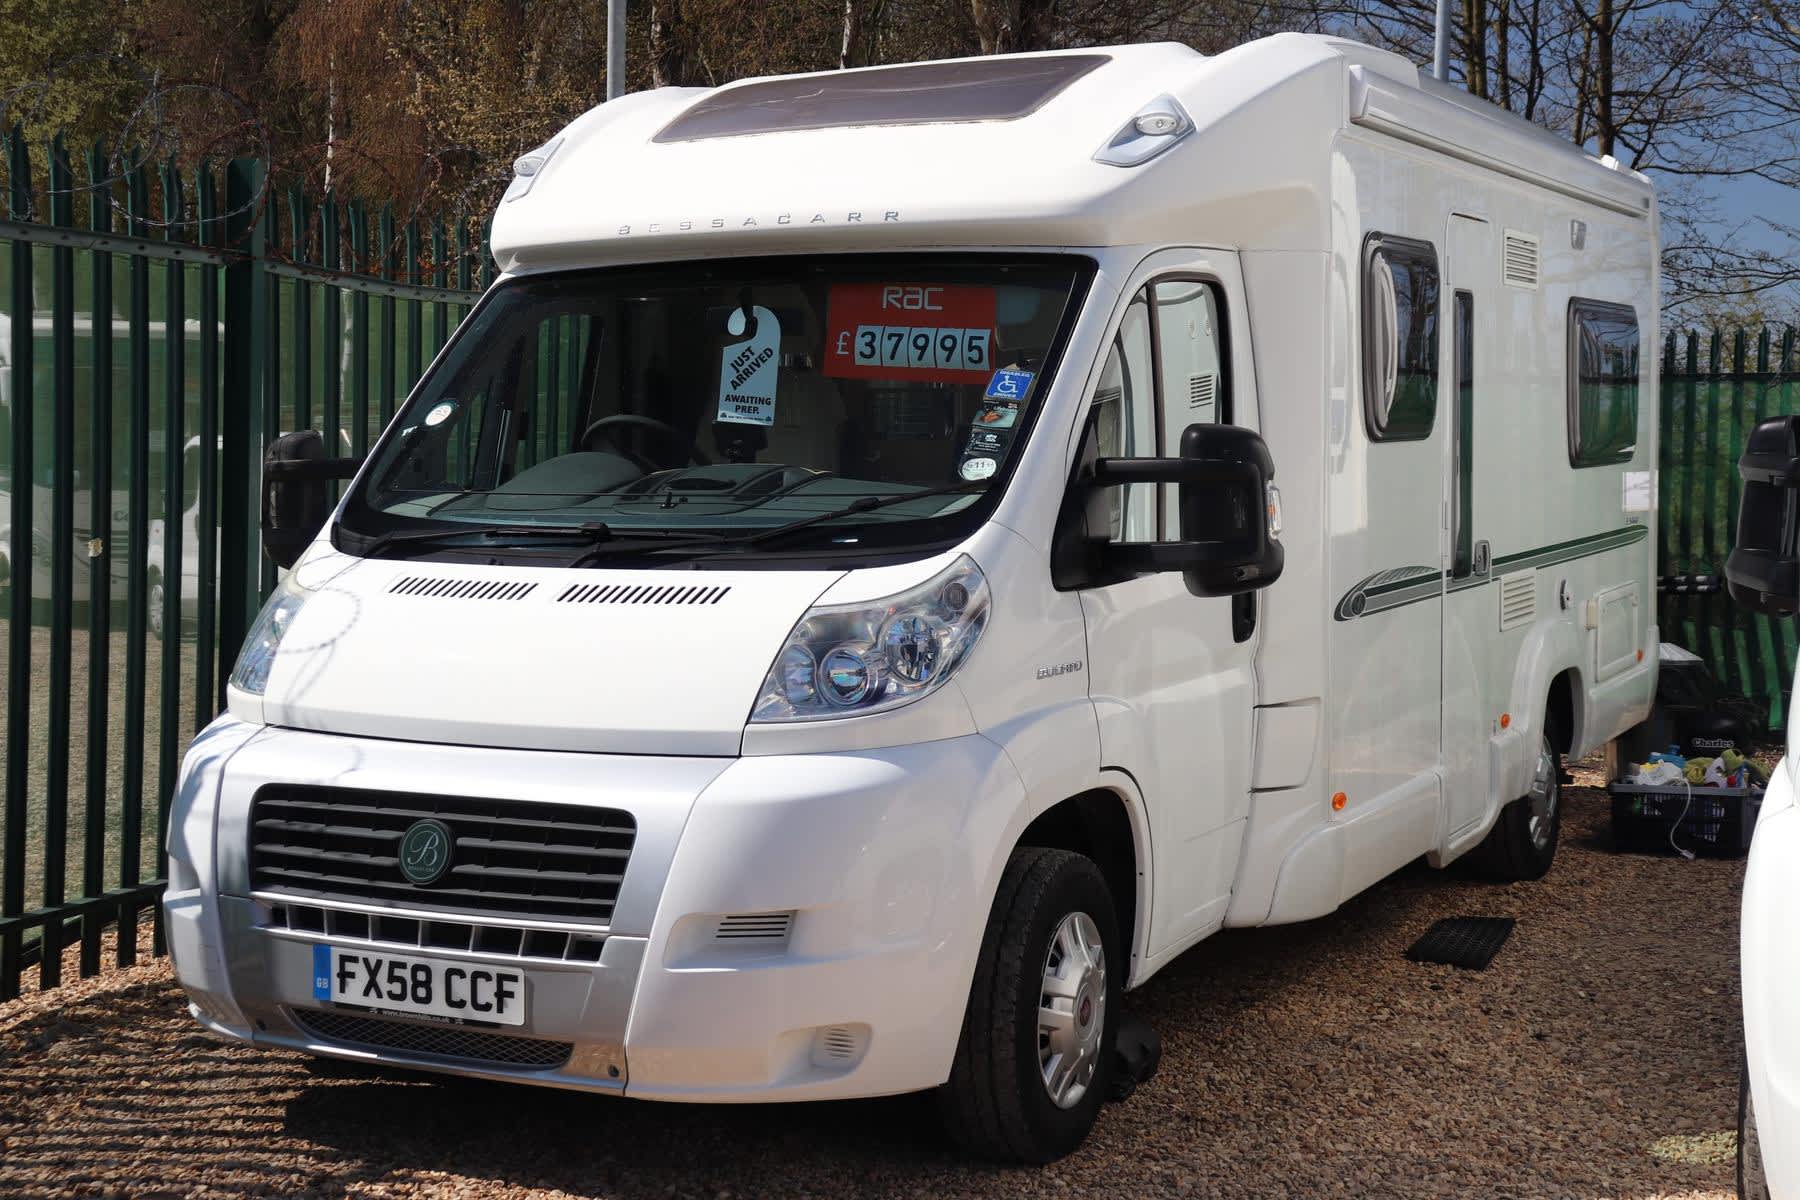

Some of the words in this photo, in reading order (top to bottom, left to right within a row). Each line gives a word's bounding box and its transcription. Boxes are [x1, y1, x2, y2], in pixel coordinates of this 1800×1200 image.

[618, 210, 900, 235] BESSACARR
[730, 346, 755, 373] JUST
[730, 347, 774, 390] ARRIVED
[724, 394, 772, 406] AWAITING
[735, 404, 760, 415] PREP.
[1691, 737, 1735, 749] Charles
[316, 977, 329, 989] GB
[336, 953, 433, 1005] FX58
[444, 967, 519, 1014] CCF
